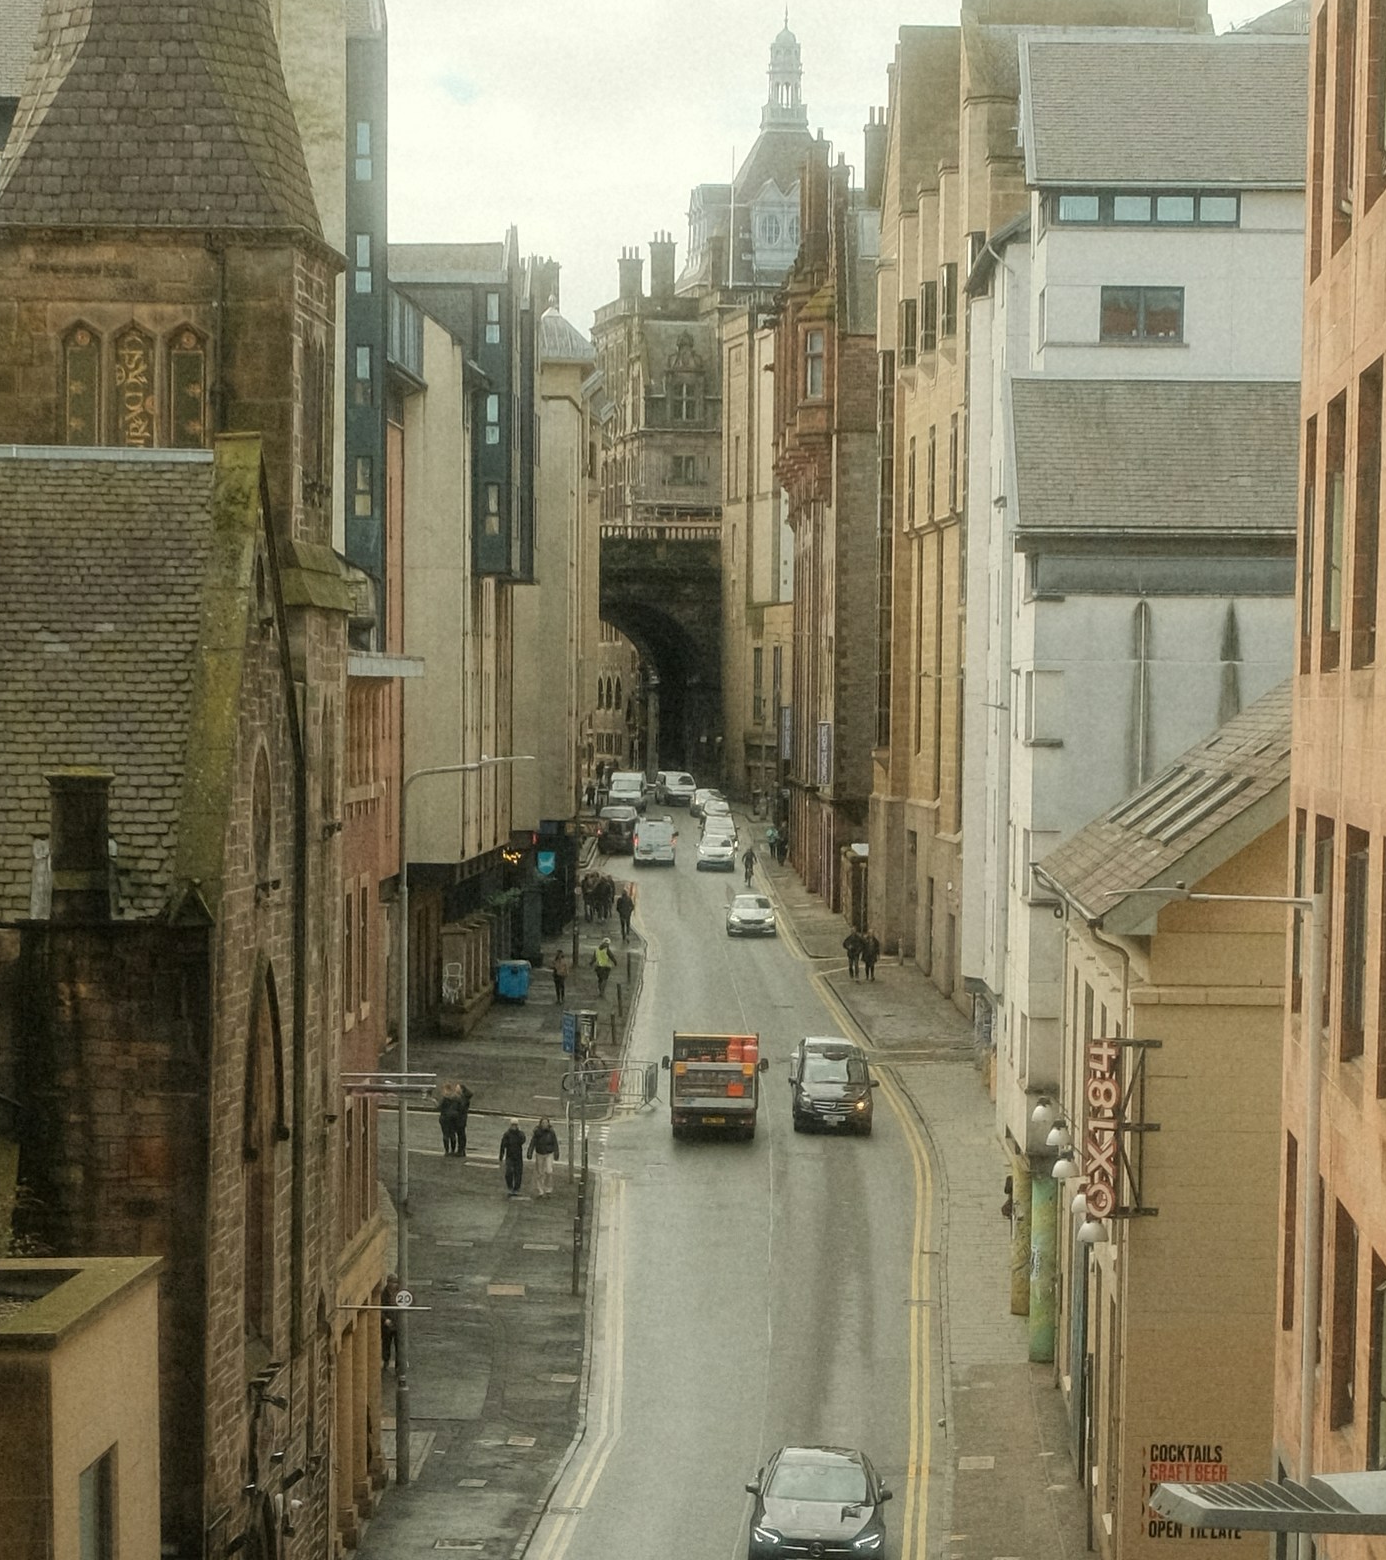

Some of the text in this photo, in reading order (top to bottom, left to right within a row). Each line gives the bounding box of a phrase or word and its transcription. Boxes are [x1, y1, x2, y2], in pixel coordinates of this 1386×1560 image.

[1087, 1041, 1120, 1218] OX184
[397, 1294, 411, 1304] 20
[1150, 1444, 1223, 1463] COCKTAILS
[1150, 1463, 1228, 1482] CRAFT BEER
[1149, 1520, 1183, 1539] OPEN
